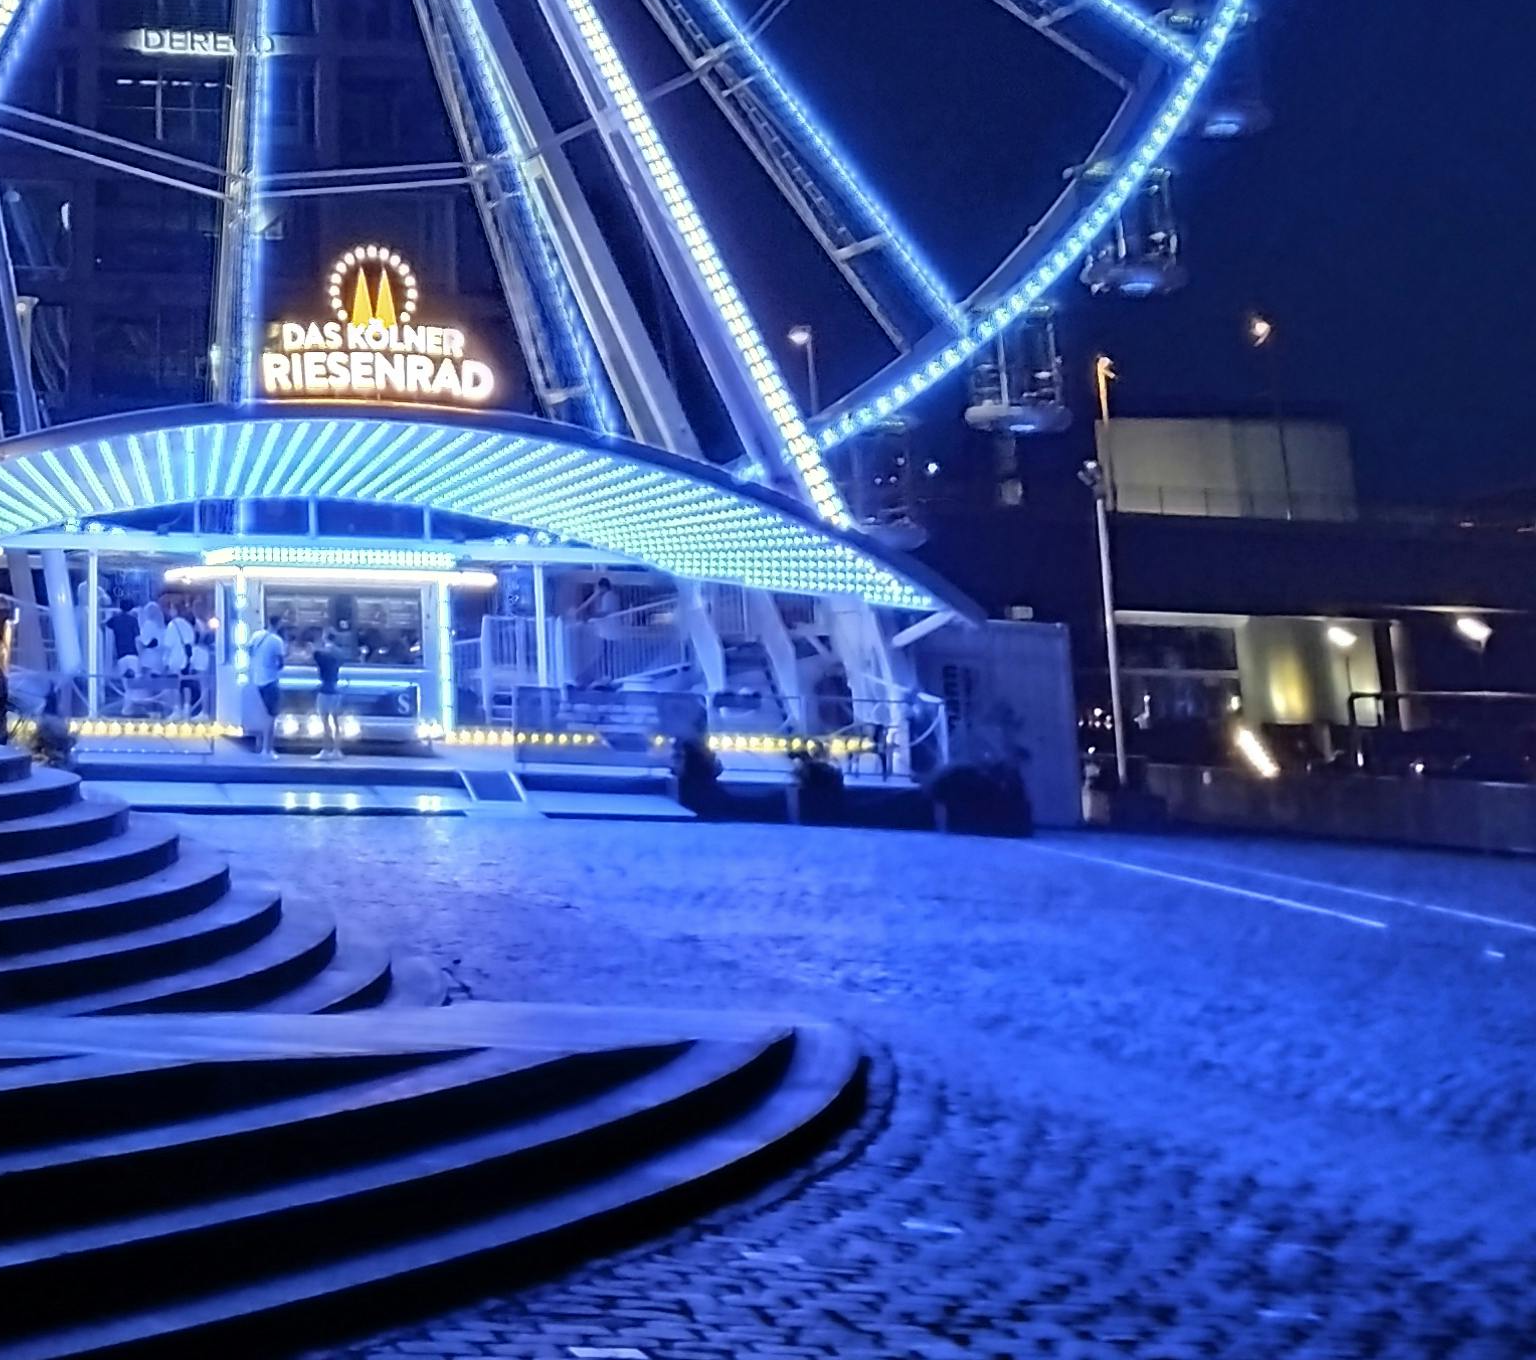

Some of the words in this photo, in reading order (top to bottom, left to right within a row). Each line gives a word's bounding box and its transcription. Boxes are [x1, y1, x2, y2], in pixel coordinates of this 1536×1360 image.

[144, 28, 275, 53] DEREO
[281, 321, 343, 352] DAS
[347, 317, 465, 357] KÖLNER
[262, 351, 495, 399] RIESENRAD
